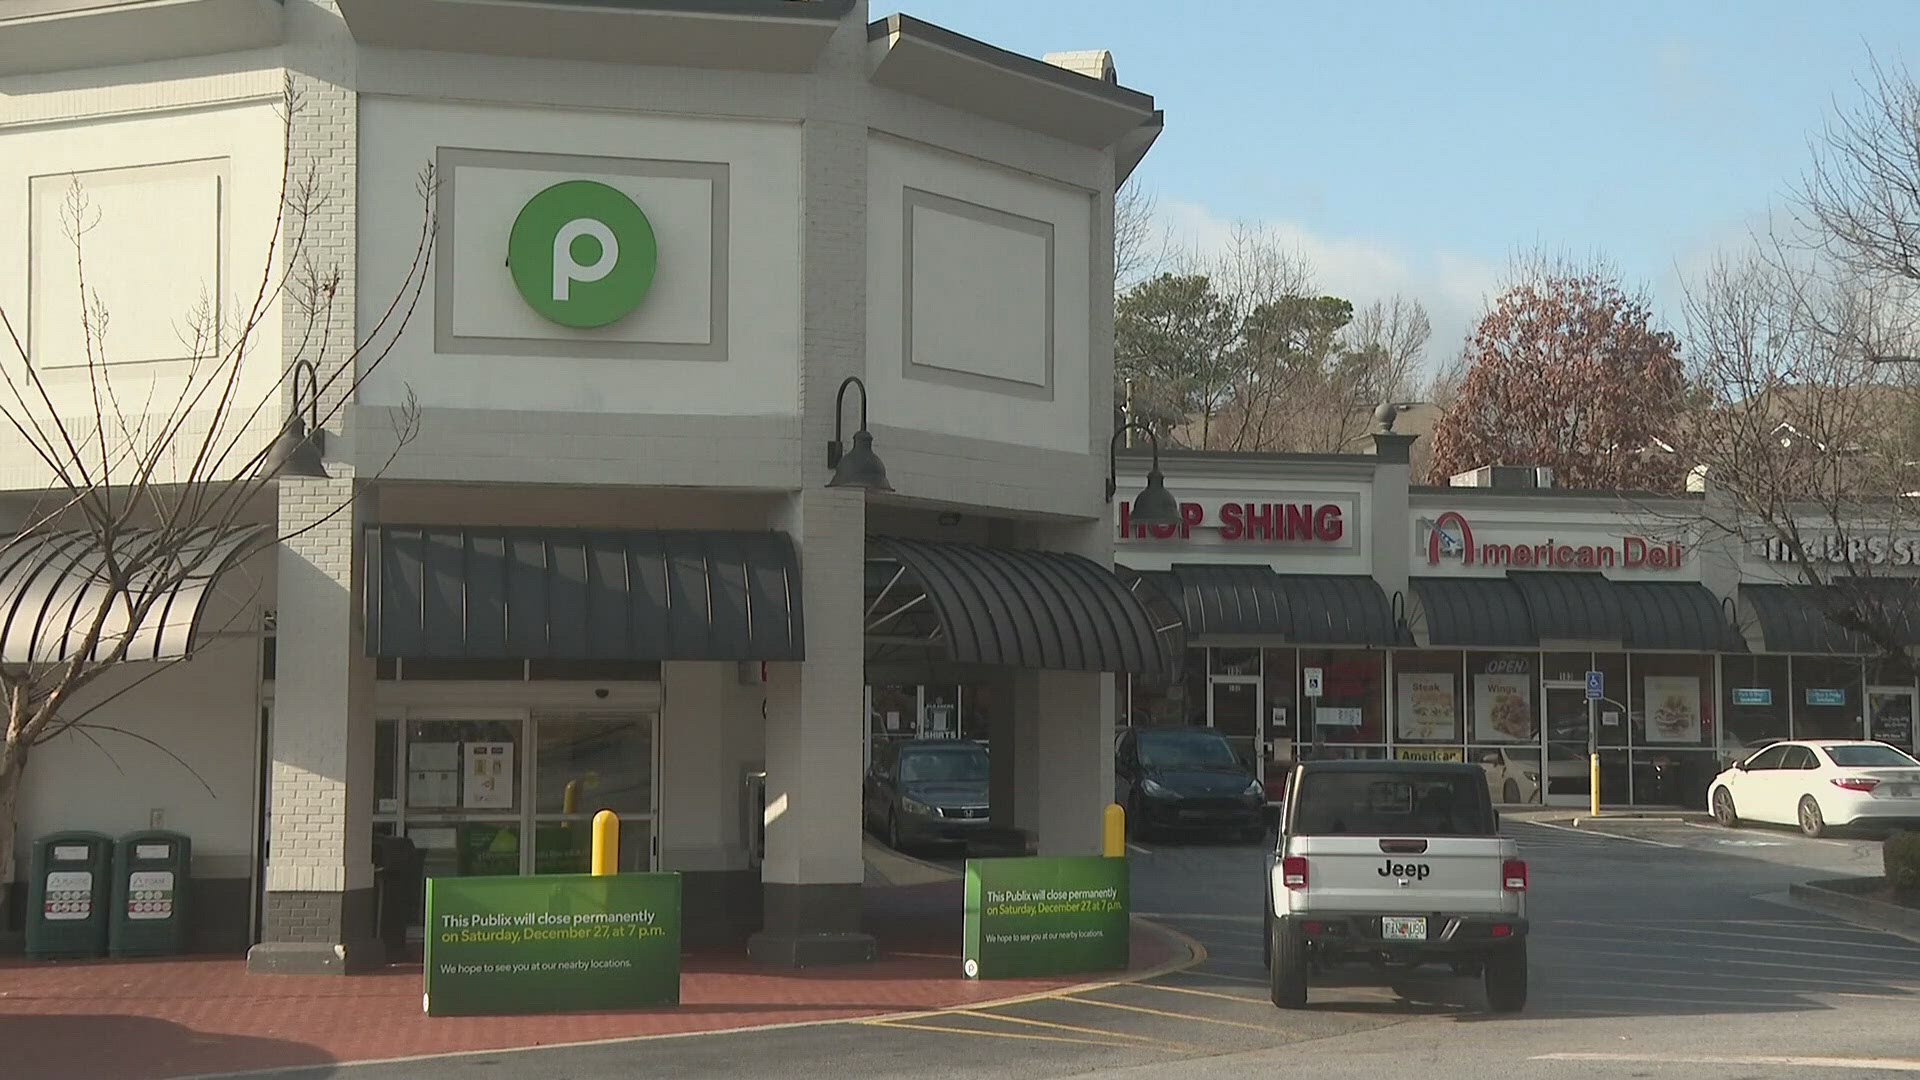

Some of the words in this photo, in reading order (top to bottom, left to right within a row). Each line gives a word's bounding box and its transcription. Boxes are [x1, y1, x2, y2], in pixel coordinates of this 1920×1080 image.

[1219, 503, 1343, 541] SHING
[1427, 511, 1614, 567] American
[1624, 537, 1681, 568] Deli
[1488, 660, 1524, 673] OPEN
[1412, 683, 1440, 692] Steak
[1488, 684, 1517, 695] Wings
[924, 731, 956, 740] SHIRTS
[1378, 860, 1430, 880] Jeep
[987, 891, 1005, 902] This
[1006, 890, 1031, 902] Publix
[1032, 890, 1046, 901] will
[1047, 889, 1068, 900] close
[1069, 887, 1118, 902] permanently
[987, 907, 998, 915] on
[1000, 904, 1037, 917] Saturday,
[1038, 902, 1080, 914] December
[1092, 901, 1100, 911] at
[1102, 900, 1107, 910] 7
[442, 914, 469, 928] This
[472, 913, 511, 927] Publix
[514, 912, 535, 925] will
[538, 911, 571, 925] close
[573, 909, 655, 927] permanently
[442, 932, 459, 943] on
[461, 928, 521, 943] Saturday,
[524, 926, 592, 940] December
[594, 924, 610, 939] 27,
[612, 926, 625, 937] at
[628, 924, 636, 936] 7
[639, 926, 666, 940] p.m.
[985, 934, 997, 943] We
[997, 934, 1012, 944] hope
[1031, 934, 1042, 943] you
[1059, 931, 1078, 940] nearby
[1079, 930, 1104, 938] locations.
[441, 964, 457, 974] We
[458, 963, 482, 975] hope
[484, 964, 494, 973] to
[495, 963, 511, 973] see
[513, 962, 530, 974] you
[531, 961, 540, 971] at
[541, 961, 557, 970] our
[558, 960, 590, 971] nearby
[591, 959, 632, 969] locations.
